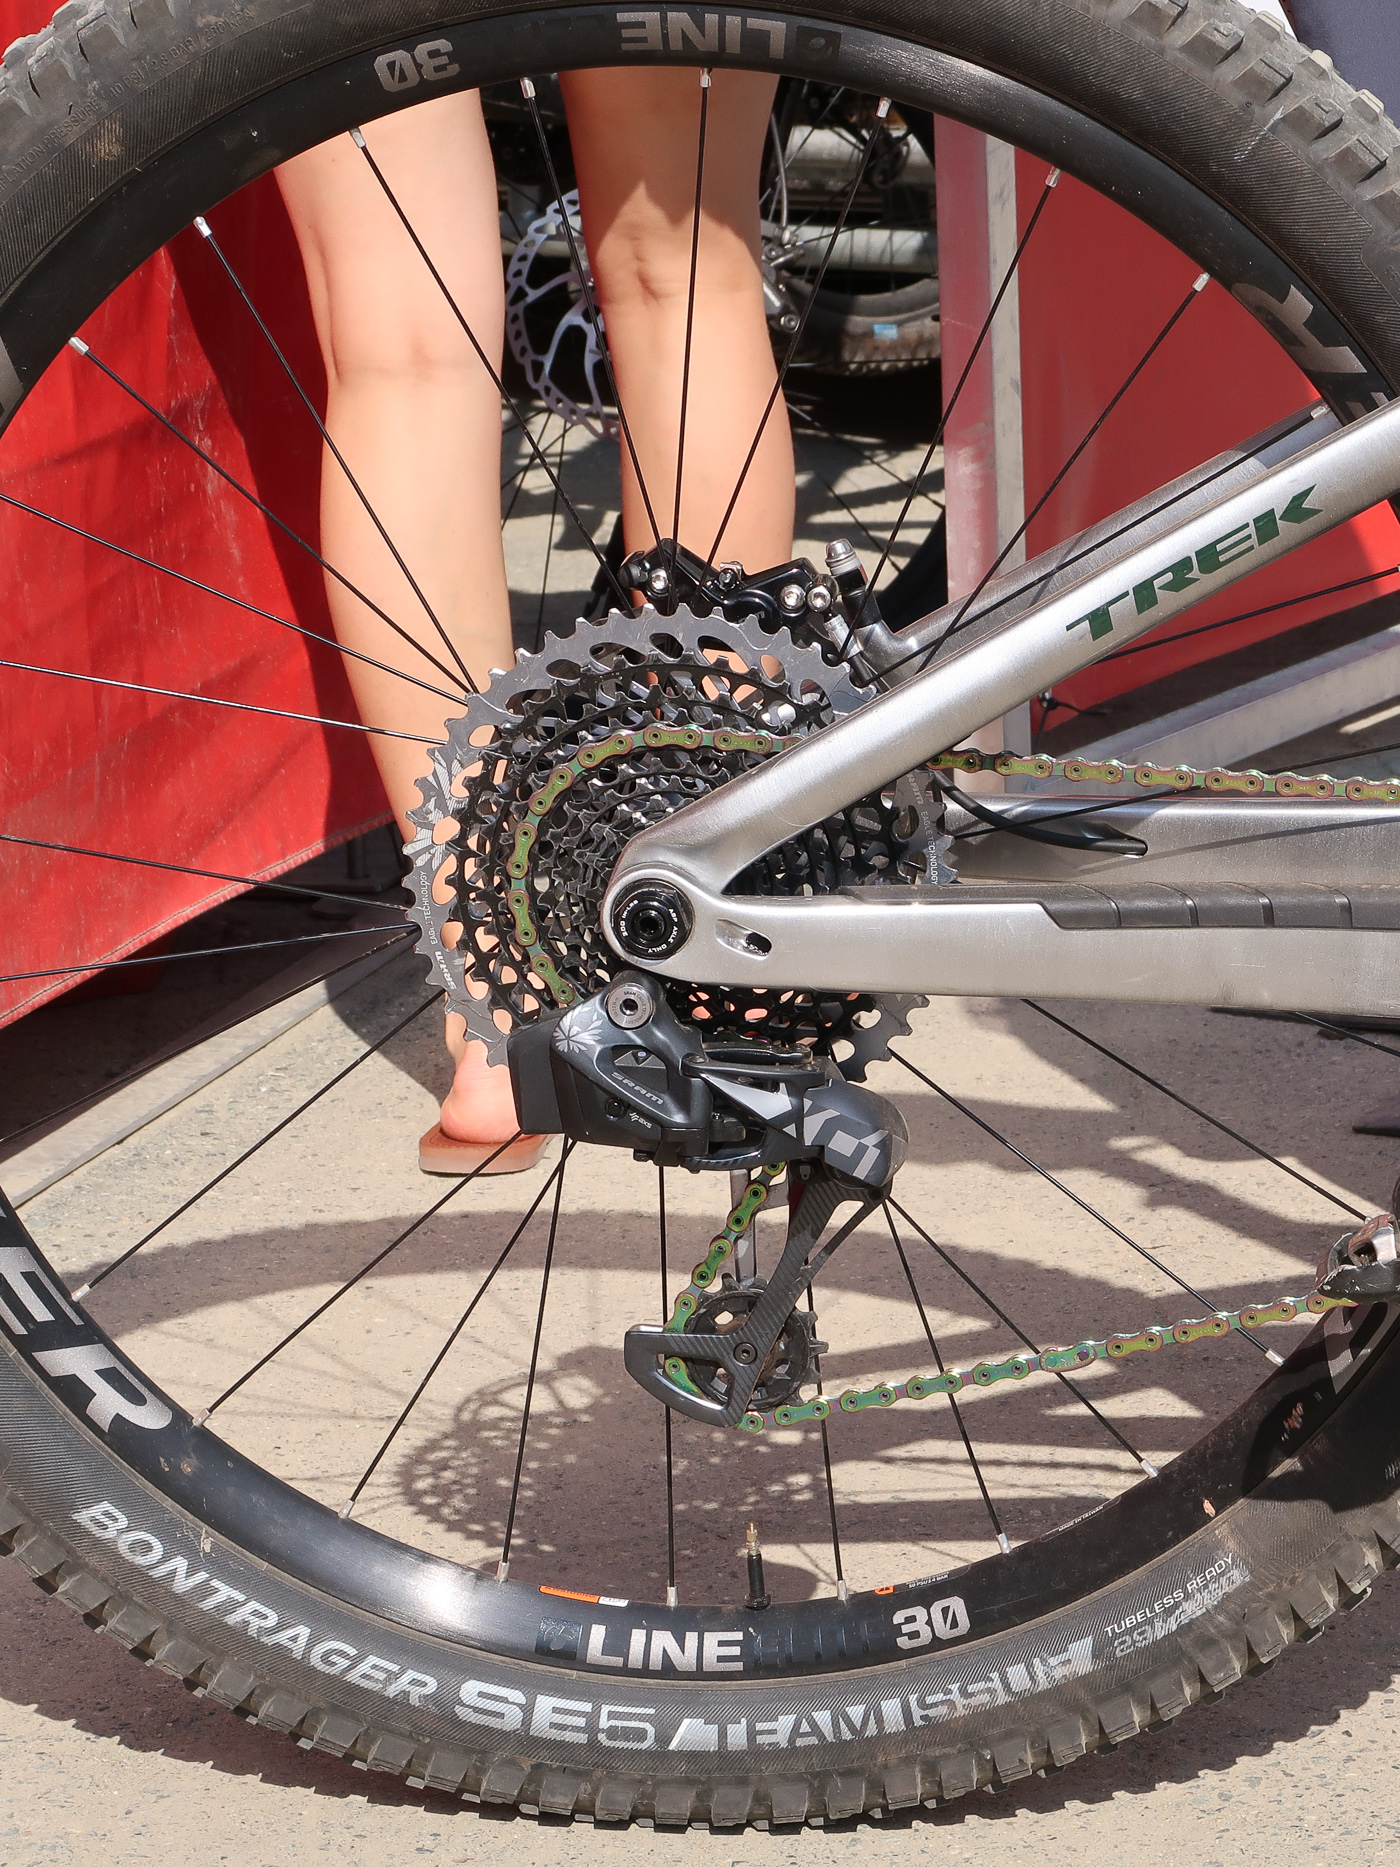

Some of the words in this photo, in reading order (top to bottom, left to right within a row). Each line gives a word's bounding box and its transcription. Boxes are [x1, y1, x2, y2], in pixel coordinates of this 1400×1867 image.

[373, 38, 461, 93] 30
[616, 12, 787, 61] LINE
[1065, 484, 1325, 642] TREK
[611, 1071, 664, 1106] SRAM
[70, 1500, 438, 1709] BONTRAGER
[454, 1679, 656, 1751] SE5
[1104, 1588, 1184, 1637] TUBELESS
[1186, 1553, 1234, 1593] READY
[586, 1623, 744, 1672] LINE
[892, 1596, 971, 1650] 30
